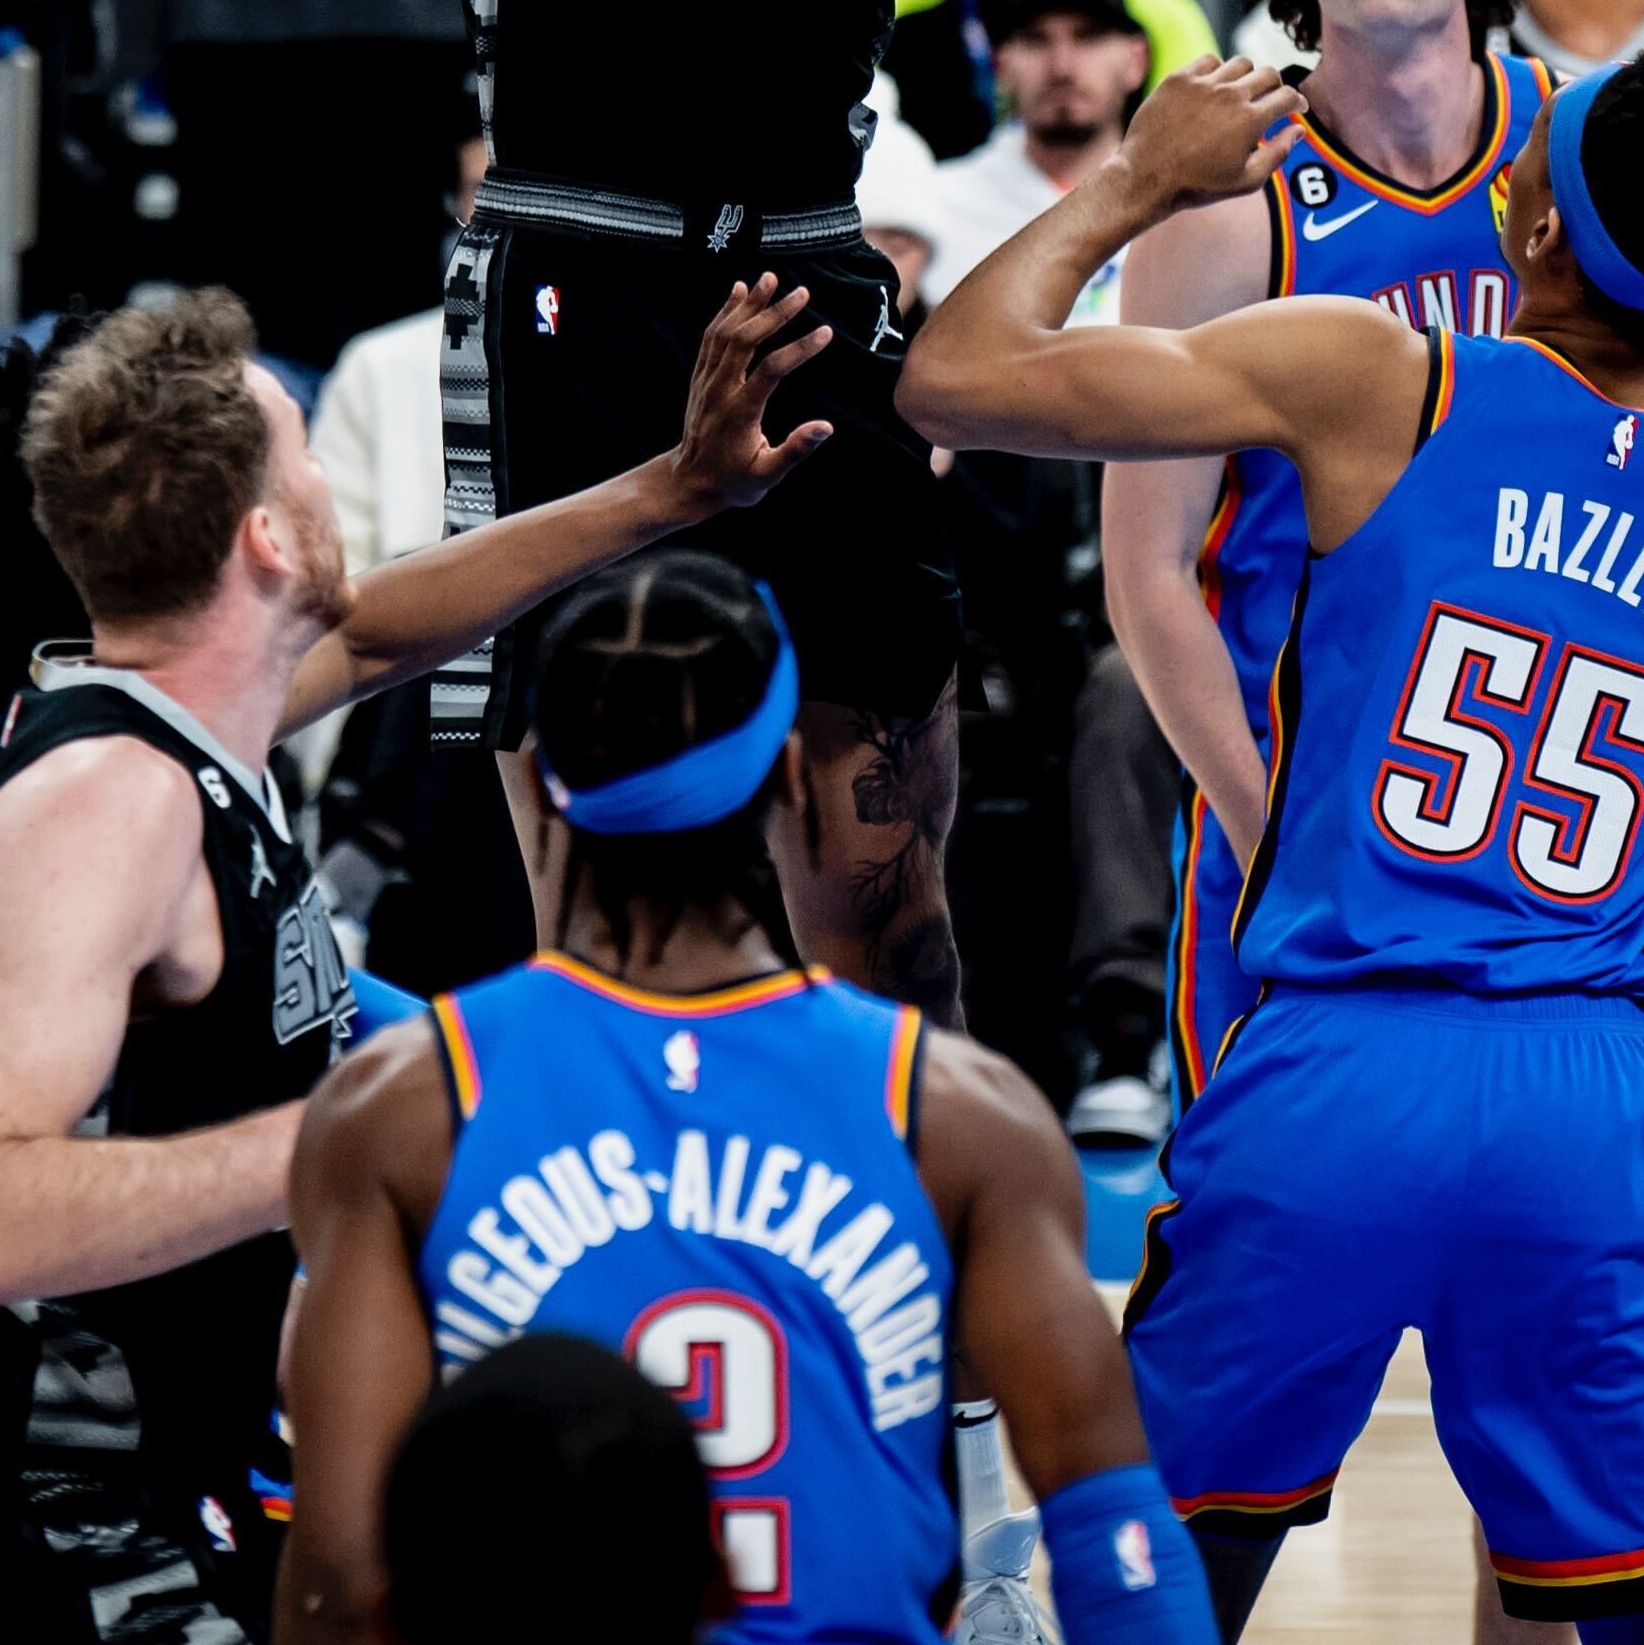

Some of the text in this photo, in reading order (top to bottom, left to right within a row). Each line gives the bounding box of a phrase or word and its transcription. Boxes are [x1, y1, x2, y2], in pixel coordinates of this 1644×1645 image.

[1297, 165, 1330, 206] 6
[197, 765, 232, 809] 6
[435, 1129, 945, 1433] ILGEOUS-ALEXANDER
[622, 1286, 792, 1607] 2
